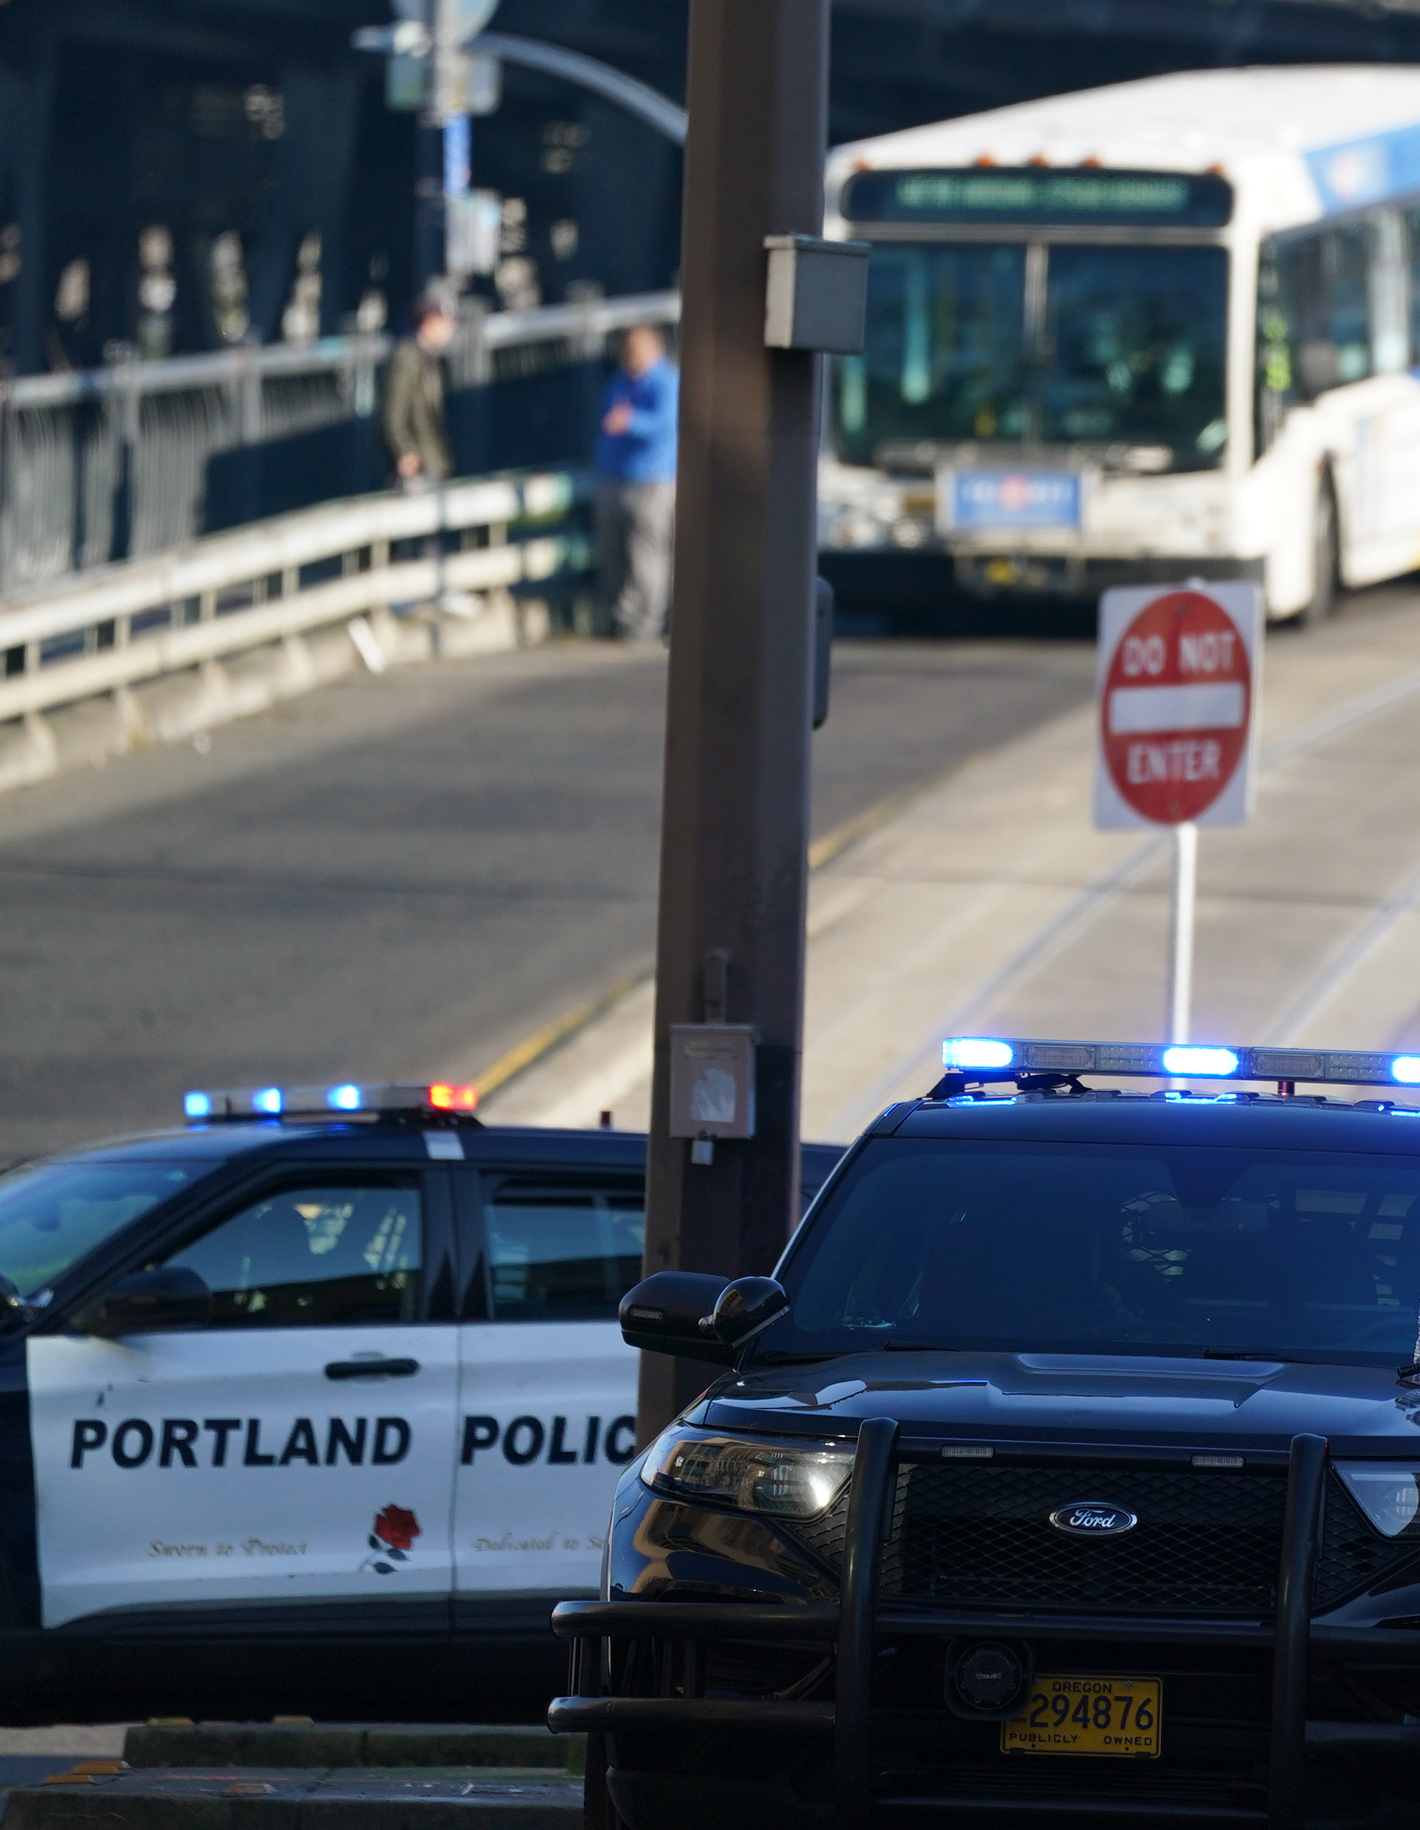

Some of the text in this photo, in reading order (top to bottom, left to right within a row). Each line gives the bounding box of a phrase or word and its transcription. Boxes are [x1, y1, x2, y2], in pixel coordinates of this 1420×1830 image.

[1123, 631, 1234, 677] DO NOT
[1127, 739, 1220, 784] ENTER
[70, 1415, 637, 1469] PORTLAND POLIC
[1069, 1508, 1116, 1528] Ford
[1052, 1682, 1113, 1693] OREGON
[1015, 1694, 1155, 1731] 294876
[1009, 1732, 1153, 1746] PUBLICLY OWNED
